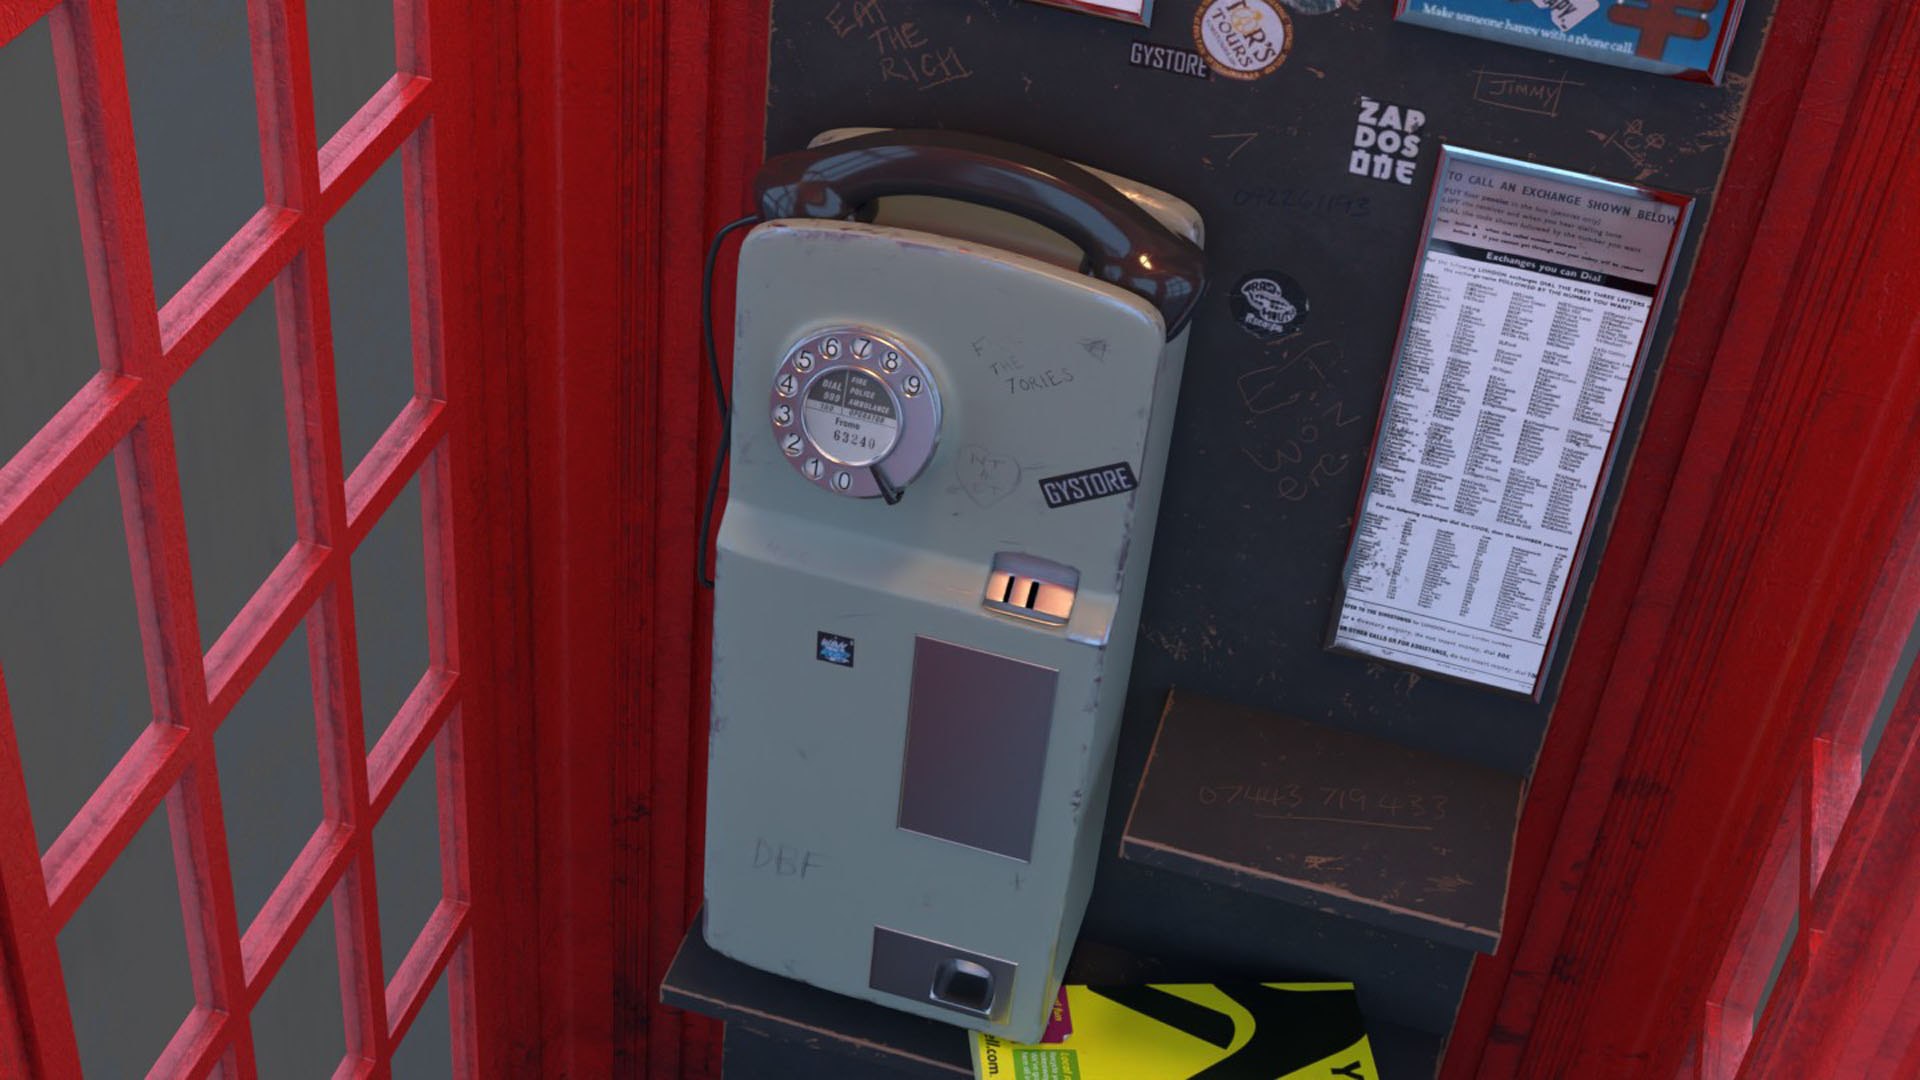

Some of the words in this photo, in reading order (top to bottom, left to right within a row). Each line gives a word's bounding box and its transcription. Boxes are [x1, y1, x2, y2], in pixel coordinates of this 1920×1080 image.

[824, 0, 887, 38] EAT
[867, 22, 929, 55] THE
[1212, 7, 1253, 67] TOURS
[1422, 4, 1454, 19] Make
[1456, 13, 1504, 30] someone
[1504, 19, 1539, 37] happy
[1540, 28, 1566, 42] with
[1568, 35, 1575, 43] a
[1575, 33, 1610, 49] phone
[1610, 41, 1634, 55] call.
[1130, 42, 1208, 78] GYSTORE
[1488, 80, 1559, 107] JIMMY
[1358, 99, 1426, 133] ZAP
[1354, 125, 1421, 158] DOS
[1448, 171, 1463, 182] TO
[1468, 175, 1494, 188] CALL
[1500, 181, 1517, 193] AN
[1522, 186, 1582, 206] EXCHANGE
[1586, 199, 1631, 216] SHOWN
[1637, 209, 1677, 225] BELOW
[1521, 202, 1533, 210] the
[1486, 251, 1536, 268] Exchanges
[1538, 263, 1558, 273] you
[1560, 268, 1577, 278] can
[1580, 271, 1602, 282] Dial
[1563, 293, 1591, 302] NUMBER
[1593, 298, 1608, 306] YOU
[1610, 302, 1633, 311] WANT
[1573, 288, 1591, 296] FIRST
[1594, 292, 1615, 300] THREE
[1617, 297, 1645, 308] LETTERS
[826, 338, 839, 356] 6
[856, 338, 871, 359] 7
[799, 351, 812, 369] 5
[886, 351, 898, 370] 8
[781, 375, 794, 394] 4
[822, 379, 842, 392] DIAL
[851, 377, 868, 386] FIRE
[908, 376, 921, 394] 9
[849, 387, 876, 400] POLICE
[777, 404, 791, 423] 3
[848, 398, 890, 414] AMBULANCE
[788, 433, 801, 452] 2
[833, 430, 876, 450] 63240
[810, 459, 819, 476] 1
[838, 472, 850, 490] 0
[1044, 467, 1132, 505] GYSTORE
[1319, 786, 1368, 811] 719
[1377, 791, 1449, 821] 433
[1330, 1060, 1365, 1080] Y
